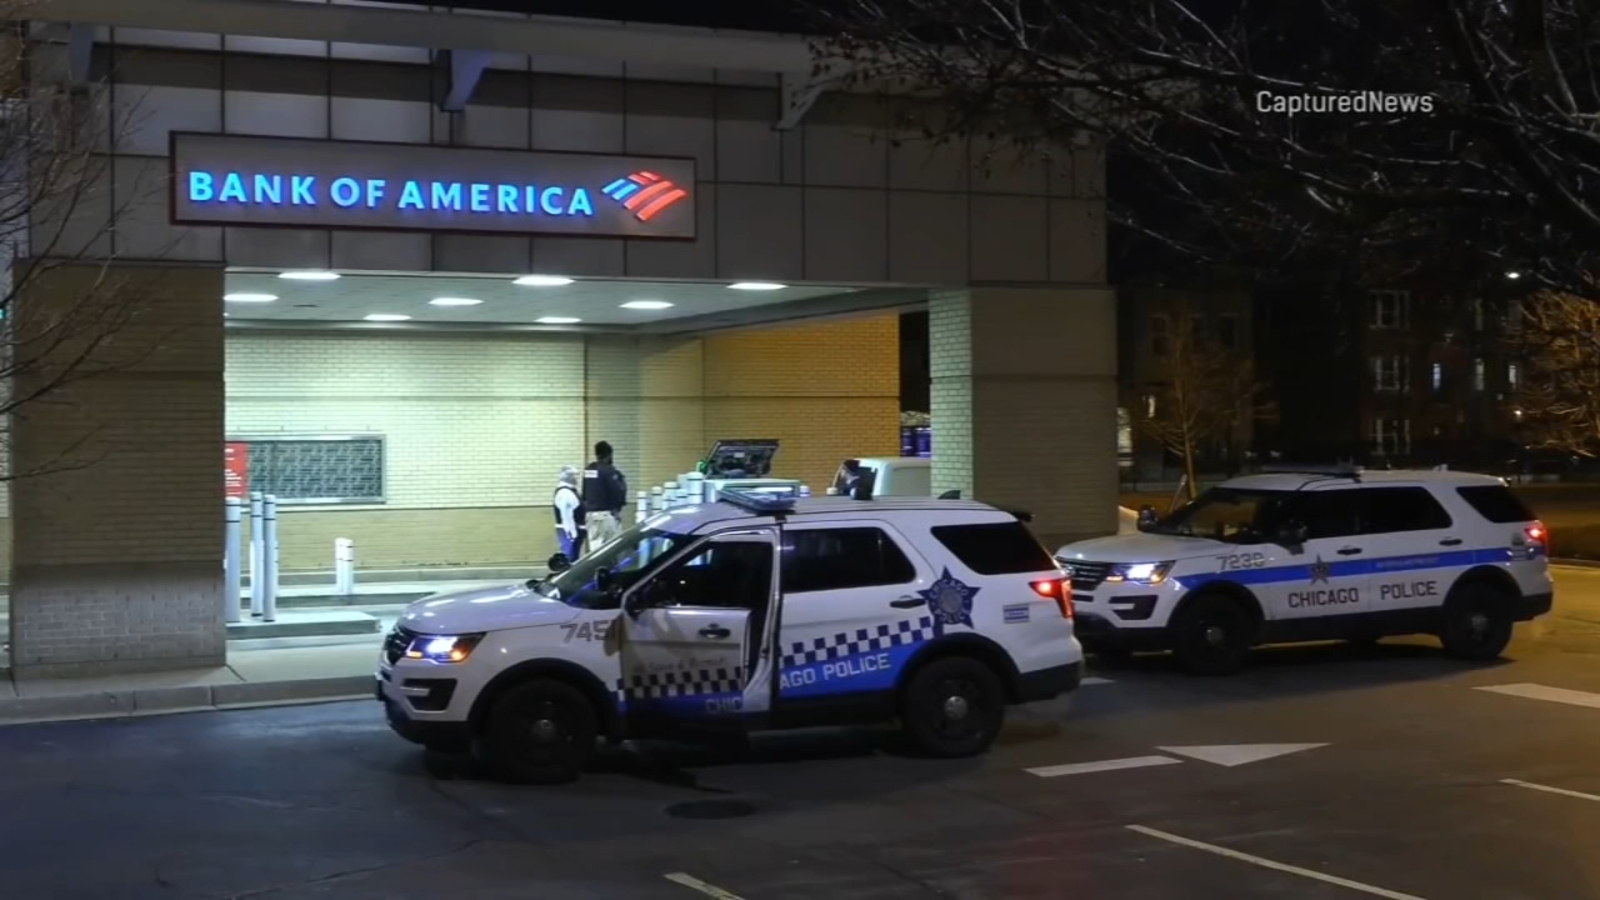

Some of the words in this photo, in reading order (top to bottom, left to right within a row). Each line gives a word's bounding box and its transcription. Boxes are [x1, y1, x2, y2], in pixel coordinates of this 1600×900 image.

[189, 170, 316, 206] BANK
[330, 177, 387, 208] OF
[398, 179, 593, 216] AMERICA
[1288, 587, 1359, 608] CHICAGO
[1380, 580, 1438, 600] POLICE
[822, 653, 891, 681] POLICE
